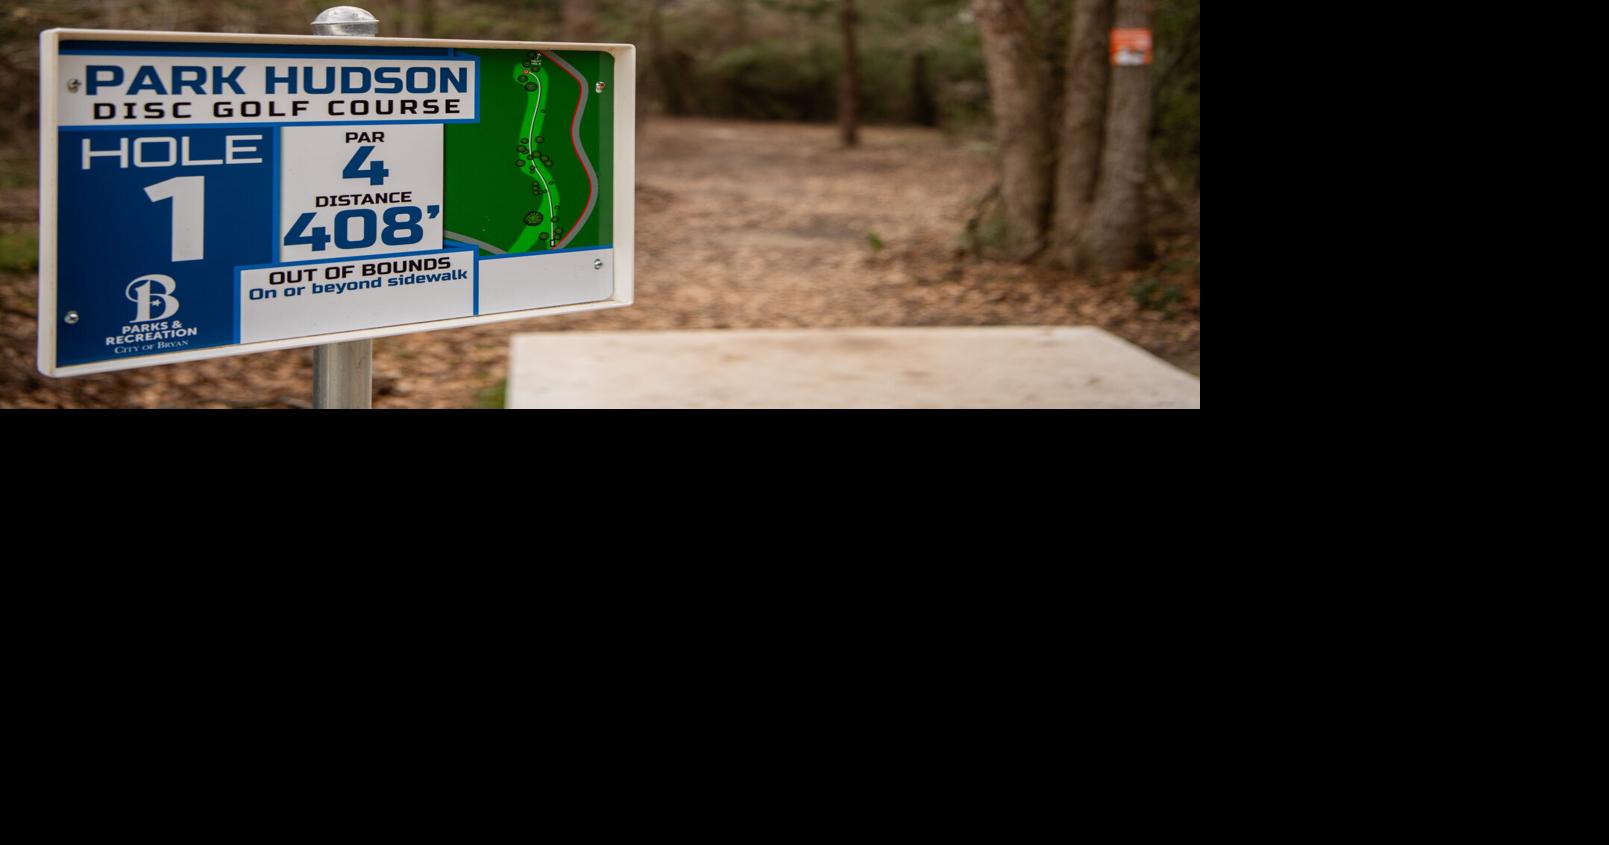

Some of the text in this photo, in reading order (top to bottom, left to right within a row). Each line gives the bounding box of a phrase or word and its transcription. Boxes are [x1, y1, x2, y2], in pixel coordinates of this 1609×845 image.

[85, 64, 468, 96] PARK HUDSON
[93, 98, 461, 120] DISC GOLF COURSE
[345, 131, 385, 143] PAR
[81, 134, 263, 170] HOLE
[342, 145, 390, 186] 4
[315, 191, 412, 208] DISTANCE
[143, 175, 205, 262] 1
[249, 268, 468, 301] On or beyond sidewalk
[269, 256, 451, 285] OUT OF BOUNDS
[105, 327, 198, 345] RECREATION
[122, 320, 183, 334] PARKS &
